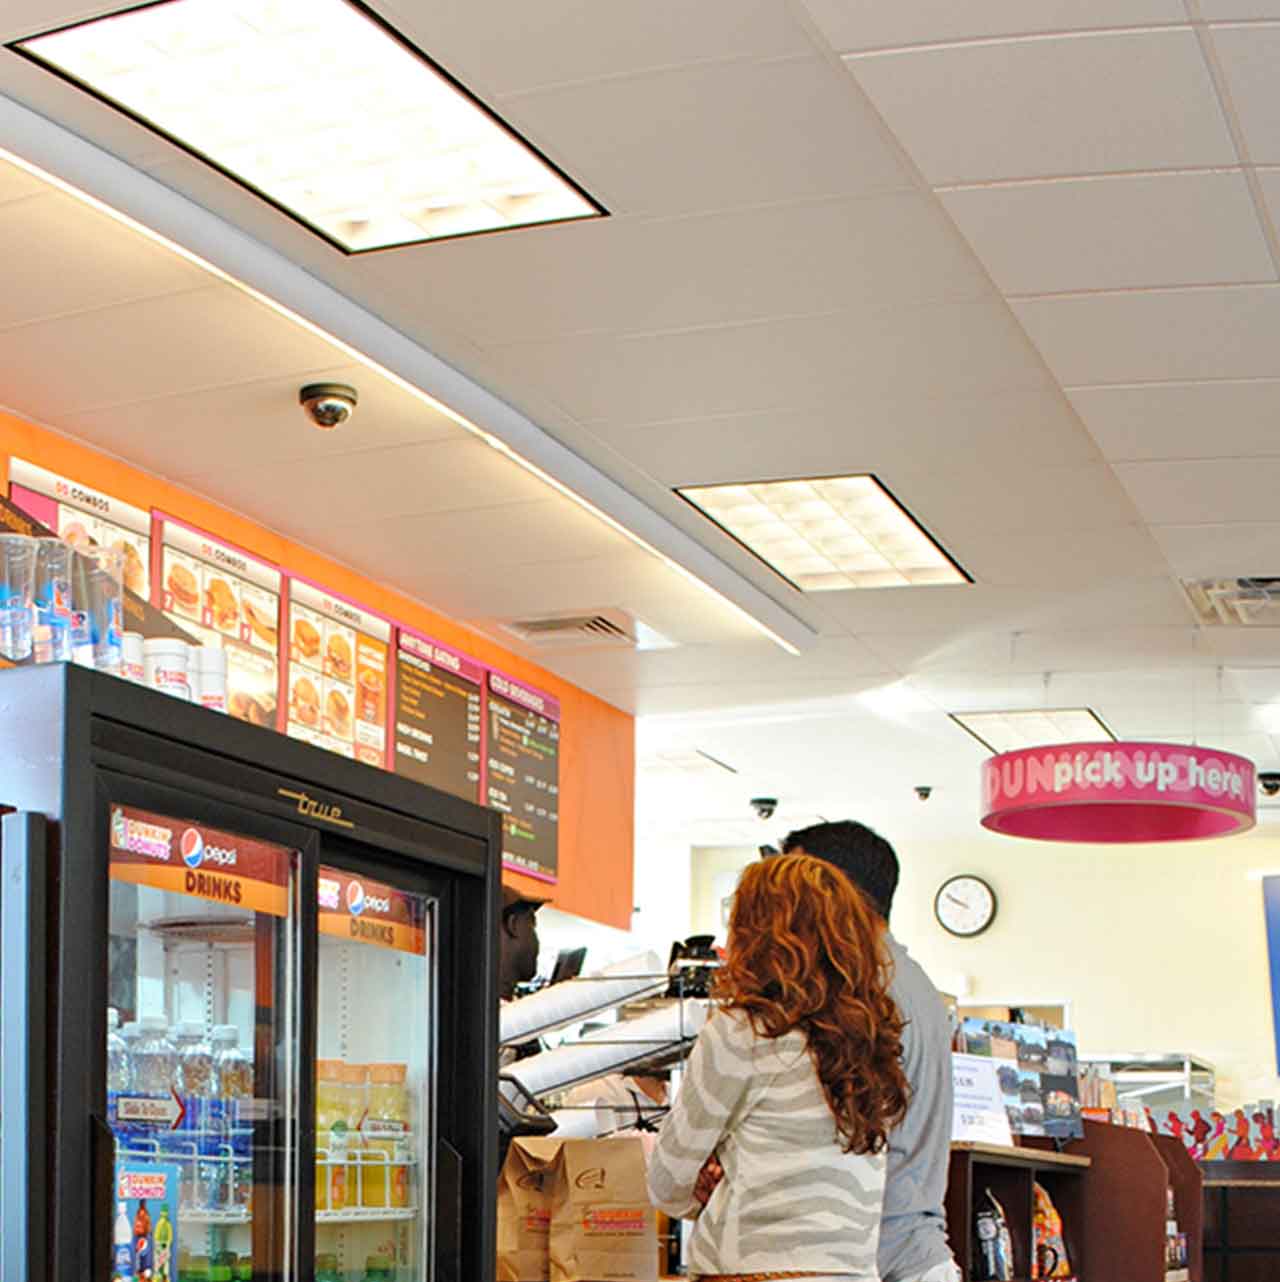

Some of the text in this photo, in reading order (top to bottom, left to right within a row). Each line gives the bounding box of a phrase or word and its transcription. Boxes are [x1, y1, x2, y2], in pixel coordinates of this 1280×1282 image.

[71, 487, 110, 513] COMBOS
[214, 547, 247, 571] COMBOS
[1055, 751, 1242, 795] pick up here
[204, 846, 237, 865] pepsi
[185, 871, 242, 904] DRINKS
[350, 918, 394, 945] DRINKS
